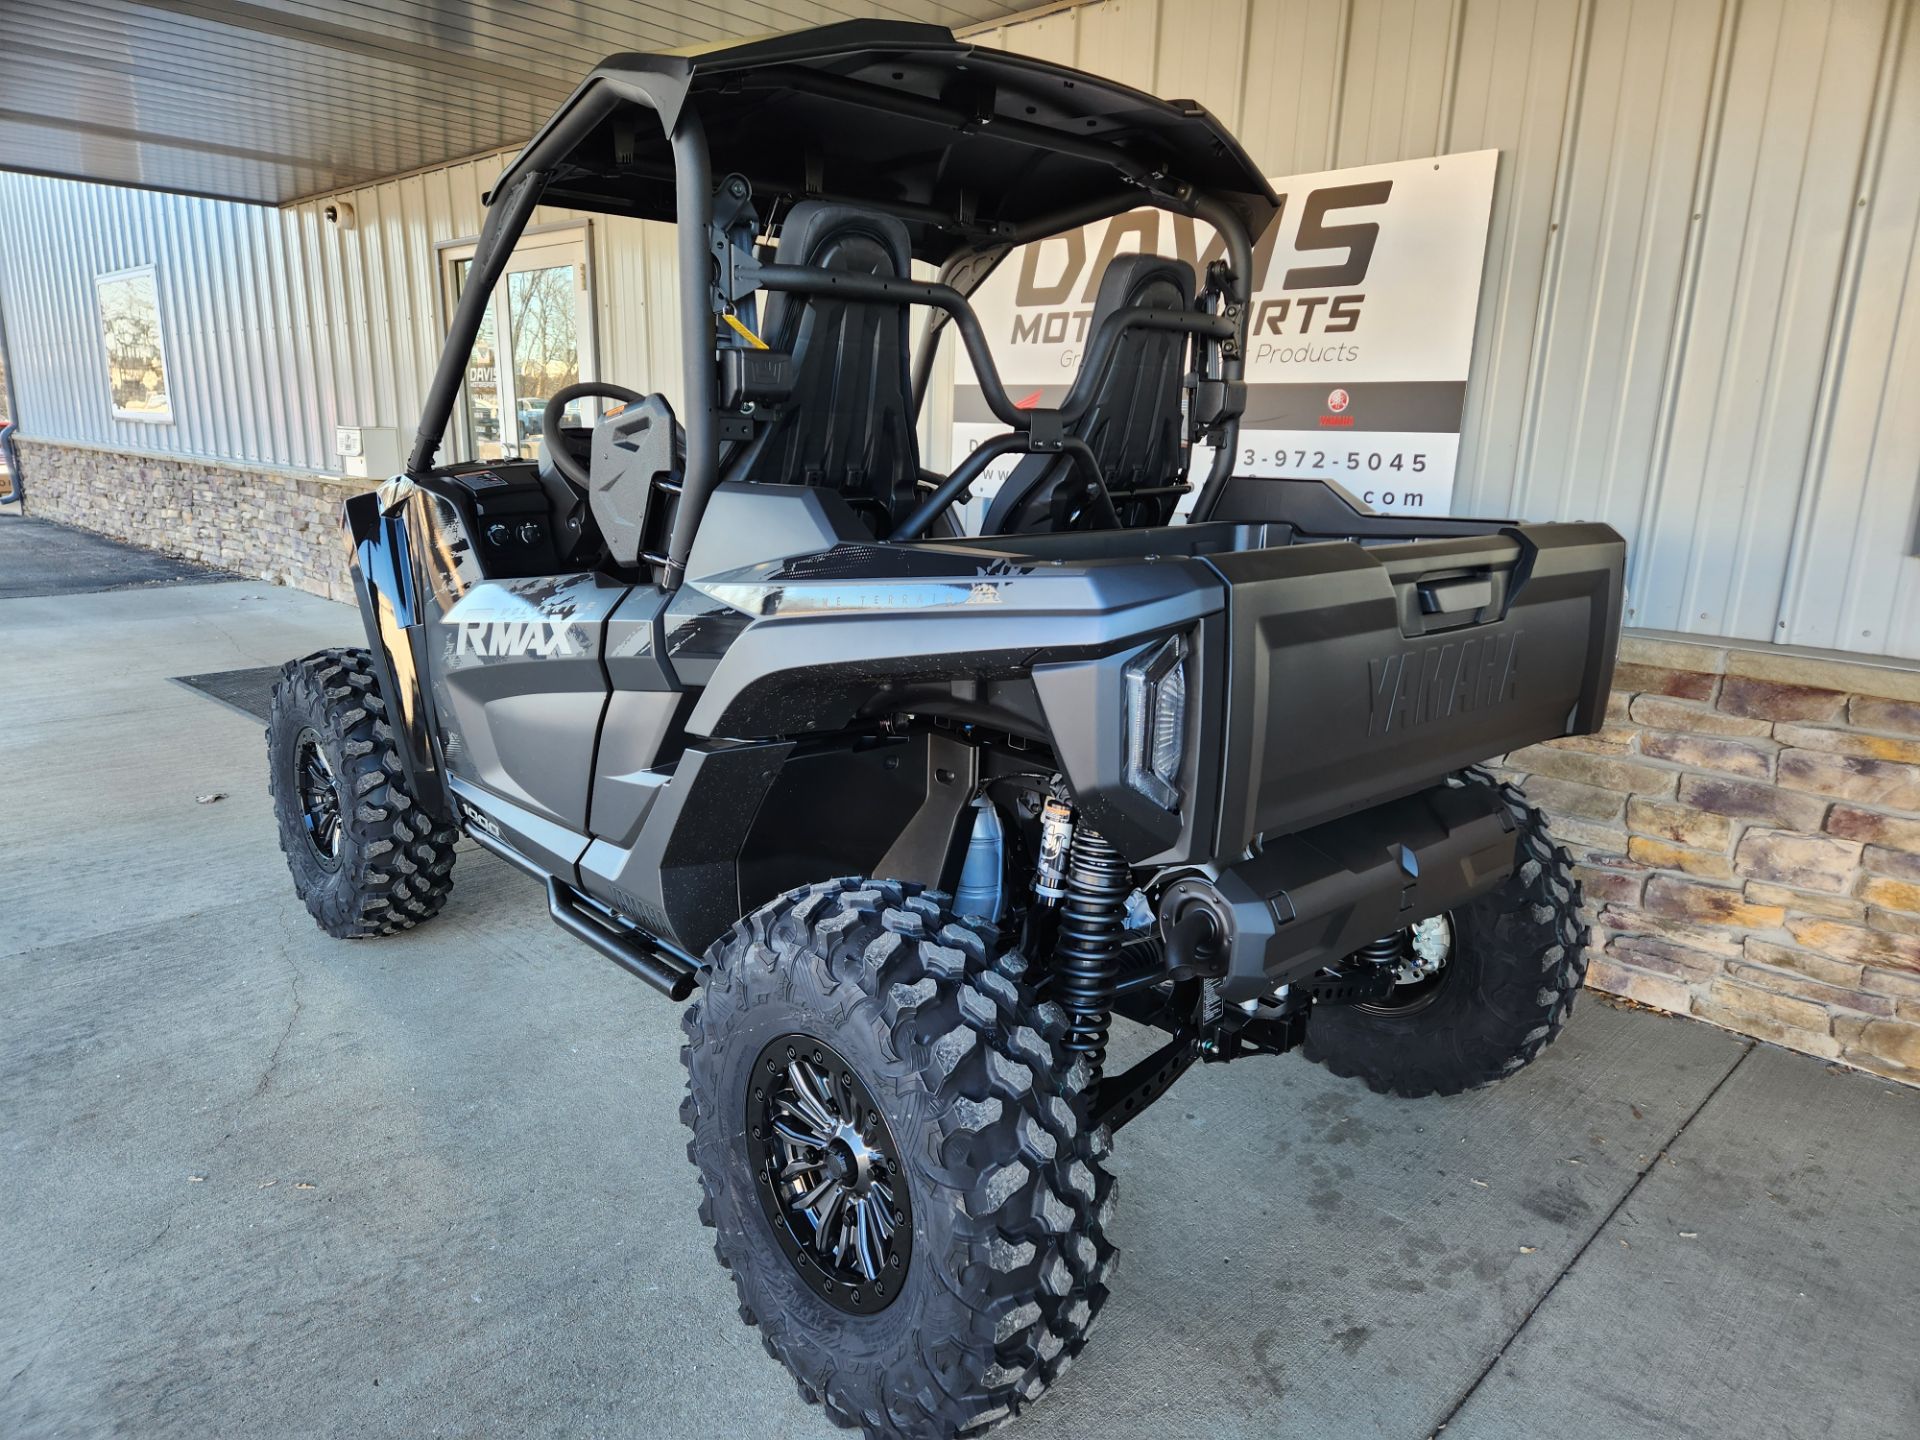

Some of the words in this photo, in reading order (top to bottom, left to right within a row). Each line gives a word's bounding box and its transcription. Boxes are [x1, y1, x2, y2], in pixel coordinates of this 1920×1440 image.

[1255, 342, 1360, 364] Products
[455, 609, 585, 657] RMAX
[1367, 628, 1526, 738] YAMAHA
[462, 803, 500, 838] 1000
